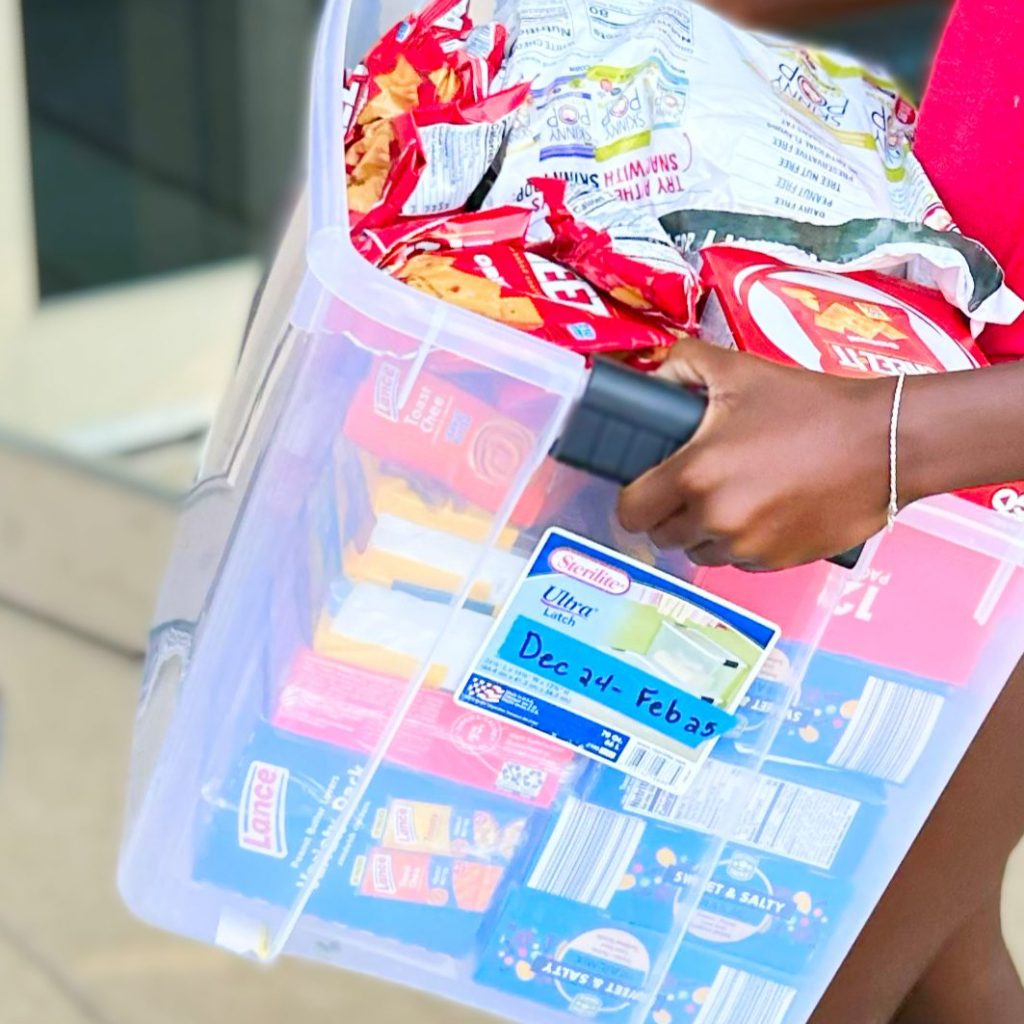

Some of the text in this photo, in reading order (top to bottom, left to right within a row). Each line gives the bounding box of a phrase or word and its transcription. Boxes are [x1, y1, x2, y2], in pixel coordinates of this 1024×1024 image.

[547, 104, 591, 128] POP
[550, 128, 592, 141] SKINNY
[772, 137, 793, 153] FREE
[657, 175, 685, 194] TRY
[778, 158, 840, 192] TREE NUT FREE
[614, 185, 641, 203] THE
[775, 176, 833, 208] PEANUT FREE
[774, 197, 826, 219] DAIRY FREE
[403, 386, 432, 426] Toast
[420, 396, 445, 433] Chee
[557, 556, 620, 589] Sterilite
[543, 585, 593, 616] Ultra
[543, 608, 576, 627] Latch
[518, 630, 569, 676] Dec
[636, 687, 682, 724] Feb
[244, 767, 276, 850] Lance
[305, 806, 326, 835] Butter
[725, 886, 737, 900] &
[739, 891, 786, 913] SALTY
[541, 962, 590, 984] SALTY
[592, 977, 604, 989] &
